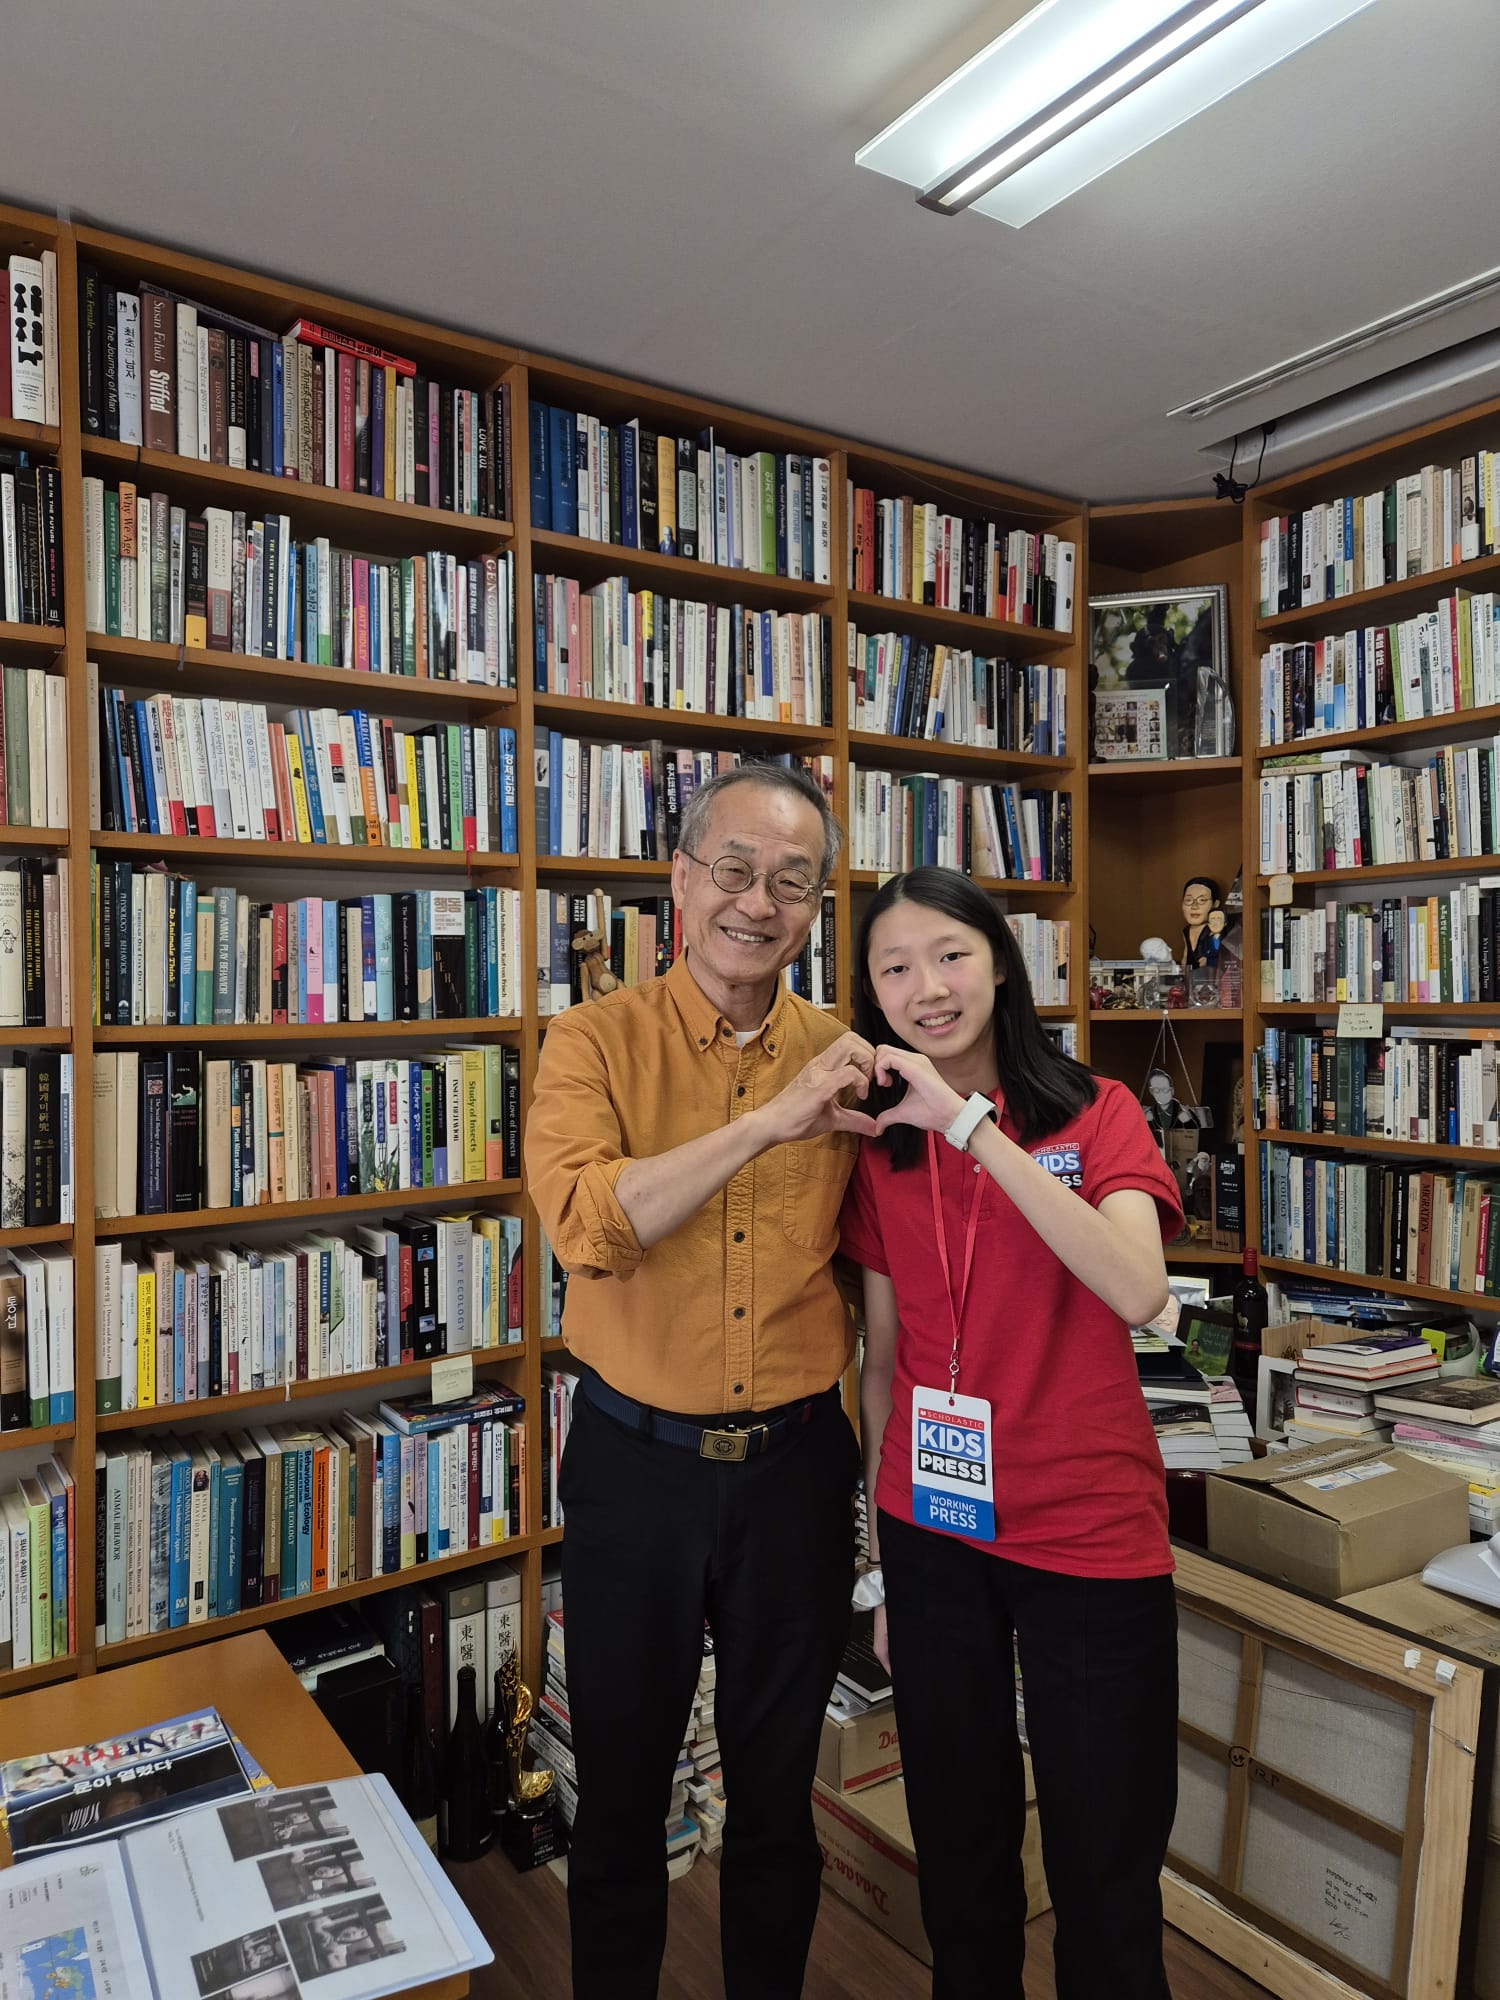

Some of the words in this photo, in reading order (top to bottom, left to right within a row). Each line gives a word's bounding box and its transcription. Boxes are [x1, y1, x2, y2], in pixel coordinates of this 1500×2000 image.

[86, 300, 96, 329] Female
[153, 300, 166, 329] Susan
[107, 325, 116, 341] The
[153, 330, 166, 362] Faludi
[106, 343, 118, 378] Journey
[286, 351, 296, 390] Feminist
[106, 381, 118, 392] of
[150, 369, 170, 414] Stiffed
[106, 393, 118, 413] Man
[236, 391, 244, 425] MALES
[284, 392, 295, 428] Critique
[303, 437, 311, 462] INCEST
[480, 429, 488, 452] LOVE
[624, 430, 634, 466] FREUD
[480, 454, 488, 469] 101
[119, 492, 133, 514] Why
[792, 489, 800, 510] SOCIAL
[119, 518, 133, 532] We
[119, 535, 133, 554] Age
[155, 548, 166, 562] Zoo
[358, 604, 366, 626] MATT
[358, 629, 366, 660] RIDLEY
[361, 714, 372, 764] PREDICTABLY
[120, 892, 128, 932] PHYSIOLOGY
[168, 908, 176, 919] Do
[168, 920, 176, 956] Animals
[184, 932, 193, 953] ANIMAL
[218, 916, 230, 941] ANIMAL
[120, 940, 128, 974] BEHAVIOR
[184, 956, 193, 974] MINDS
[218, 944, 230, 960] PLAY
[218, 962, 230, 994] BEHAVIOR
[468, 1081, 476, 1106] Study
[470, 1108, 476, 1117] of
[349, 1120, 358, 1155] BEETLES
[232, 1169, 241, 1192] Sociality
[1420, 1184, 1430, 1232] MIGRATION
[927, 1412, 984, 1429] SCHOLASTIC
[920, 1423, 982, 1458] KIDS
[920, 1453, 983, 1482] PRESS
[288, 1457, 296, 1508] BEHAVIOURAL
[97, 1496, 106, 1512] THE
[113, 1488, 121, 1519] ANIMAL
[930, 1494, 976, 1514] WORKING
[930, 1506, 977, 1530] PRESS
[39, 1510, 47, 1548] SURVIVAL
[97, 1515, 106, 1546] WISDOM
[288, 1511, 296, 1545] ECOLOGY
[302, 1502, 310, 1535] Ecology
[113, 1522, 121, 1560] BEHAVIOR
[39, 1559, 47, 1590] SICKEST
[97, 1563, 106, 1578] THE
[97, 1580, 106, 1602] HIVE
